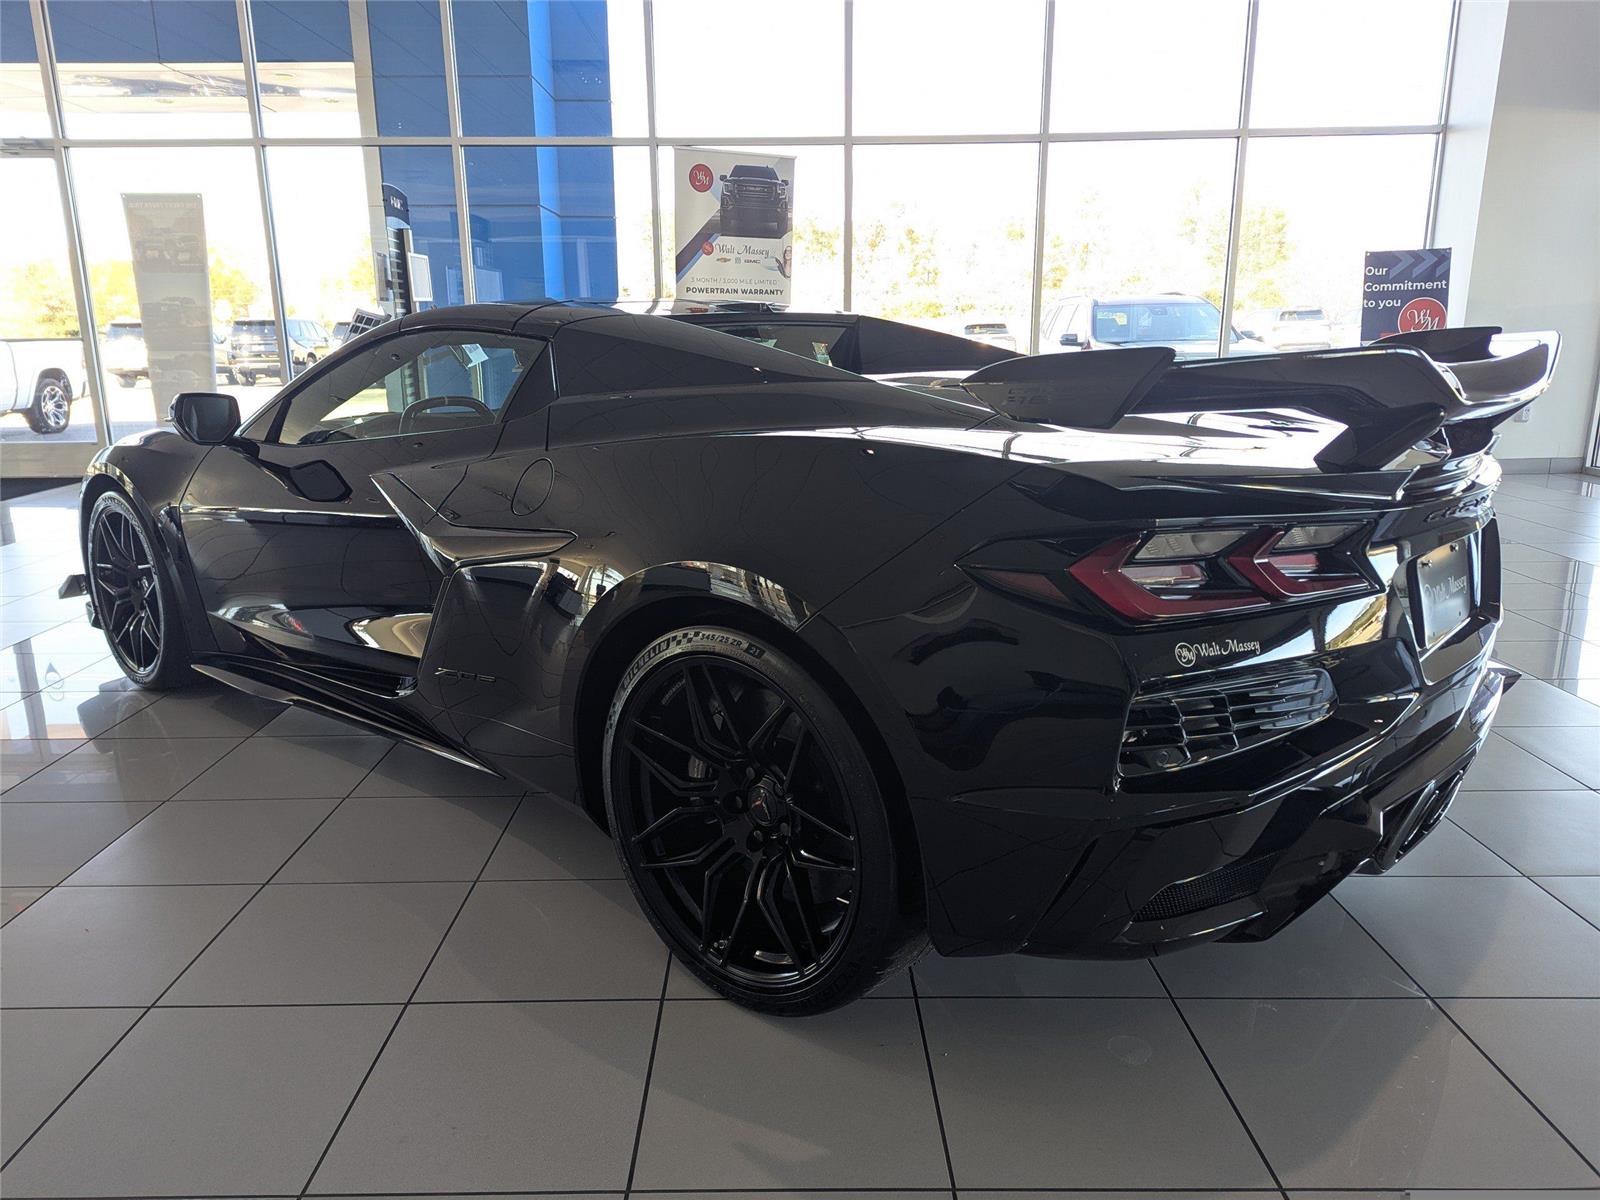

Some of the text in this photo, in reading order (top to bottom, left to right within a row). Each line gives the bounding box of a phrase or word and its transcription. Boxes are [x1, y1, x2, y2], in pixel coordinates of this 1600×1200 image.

[715, 243, 735, 254] Walt
[737, 244, 770, 259] Massey
[1365, 266, 1388, 276] Our
[686, 286, 739, 295] POWERTRAIN
[1364, 279, 1447, 292] Commitment
[1363, 298, 1401, 310] to you
[700, 633, 761, 656] 345/25 ZR 21
[1194, 641, 1221, 657] Walt
[1221, 639, 1261, 655] Massey
[622, 639, 669, 689] MICHELIN
